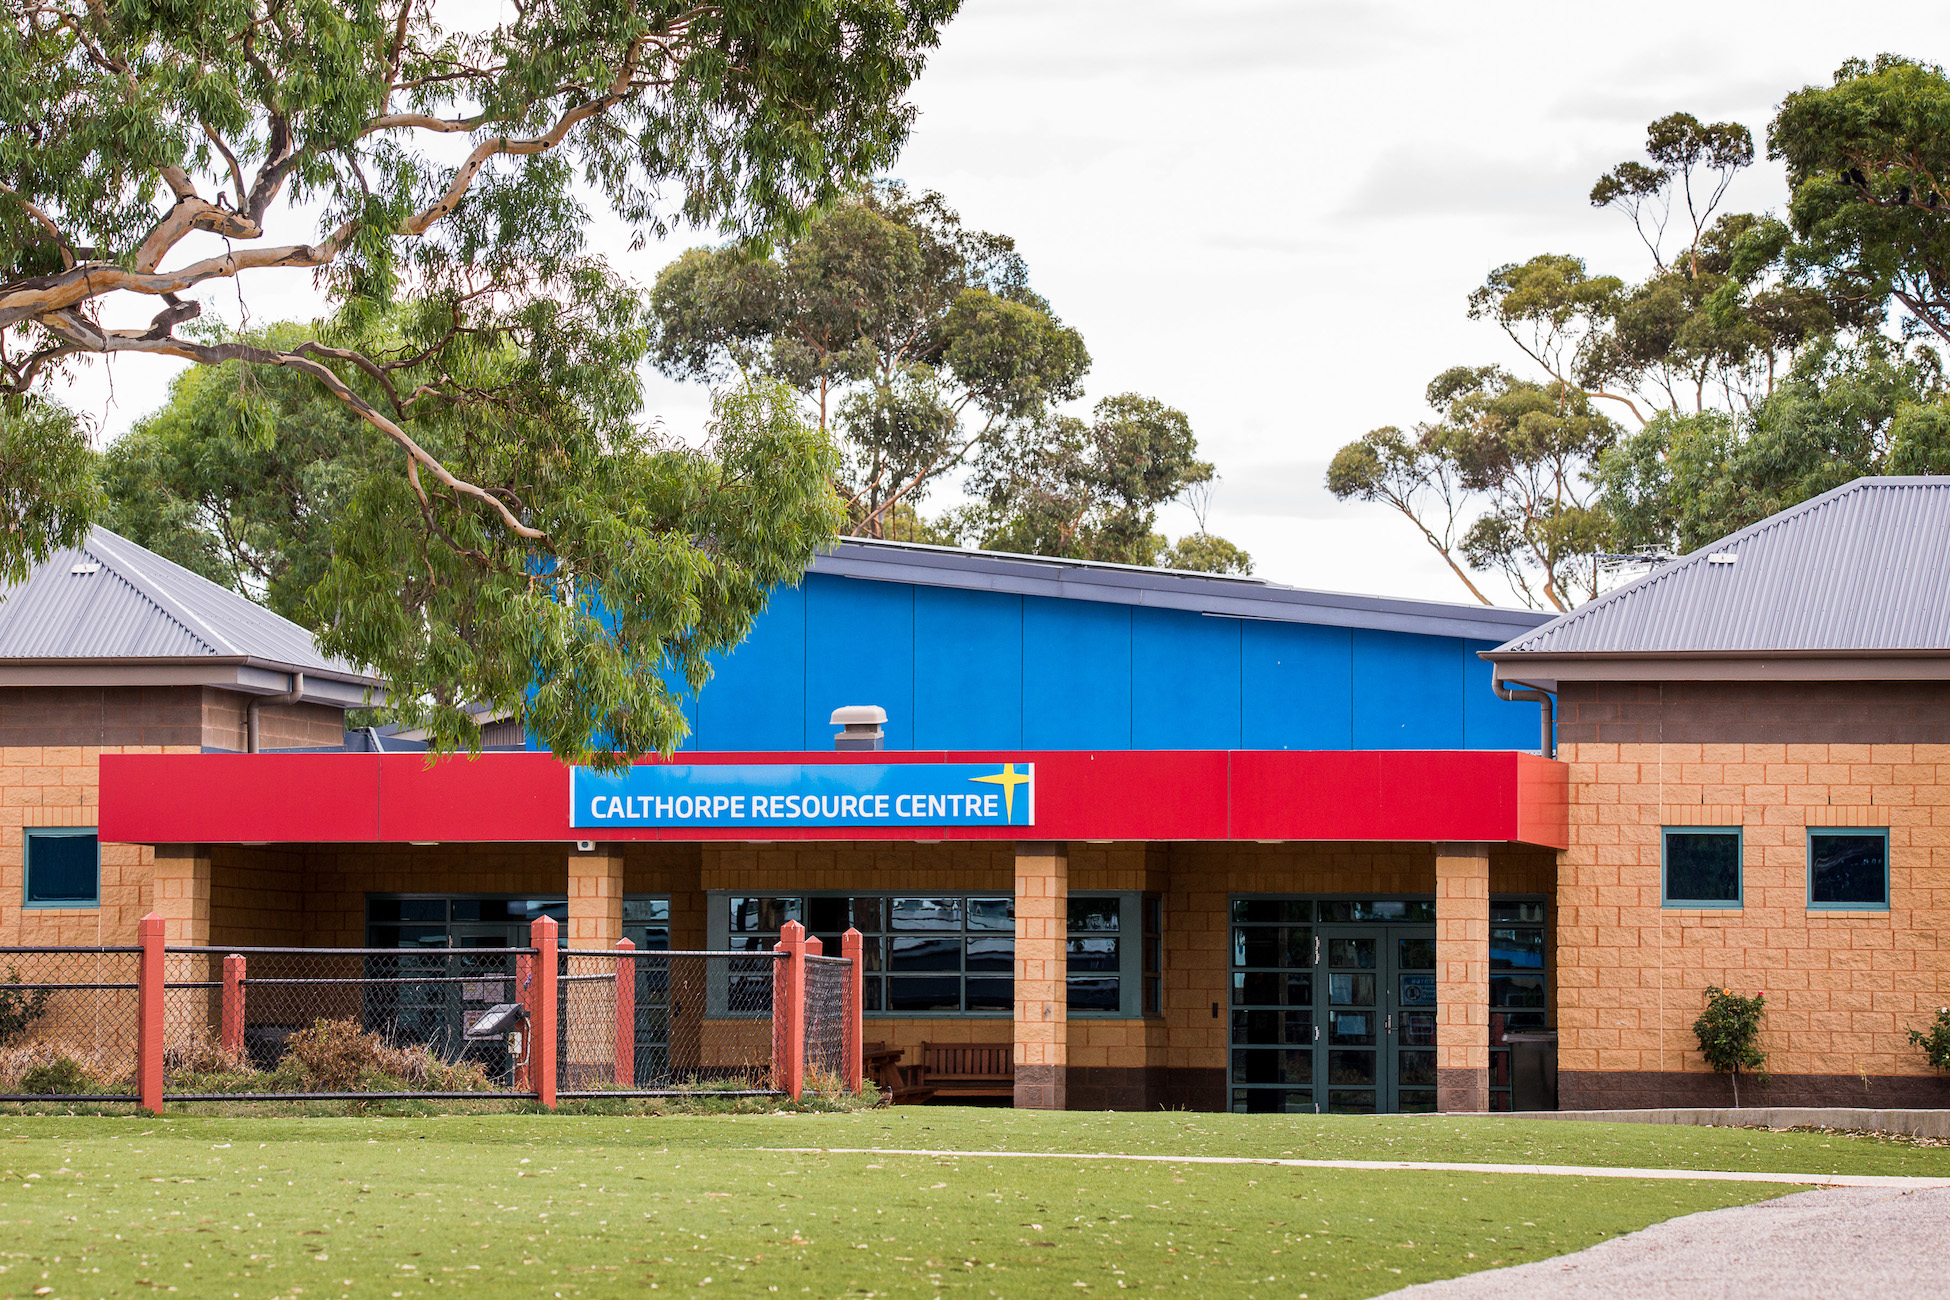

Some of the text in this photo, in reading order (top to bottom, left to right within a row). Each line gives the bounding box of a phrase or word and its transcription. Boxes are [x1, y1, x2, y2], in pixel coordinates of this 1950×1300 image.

[591, 794, 999, 818] CALTHORPE RESOURCE CENTRE
